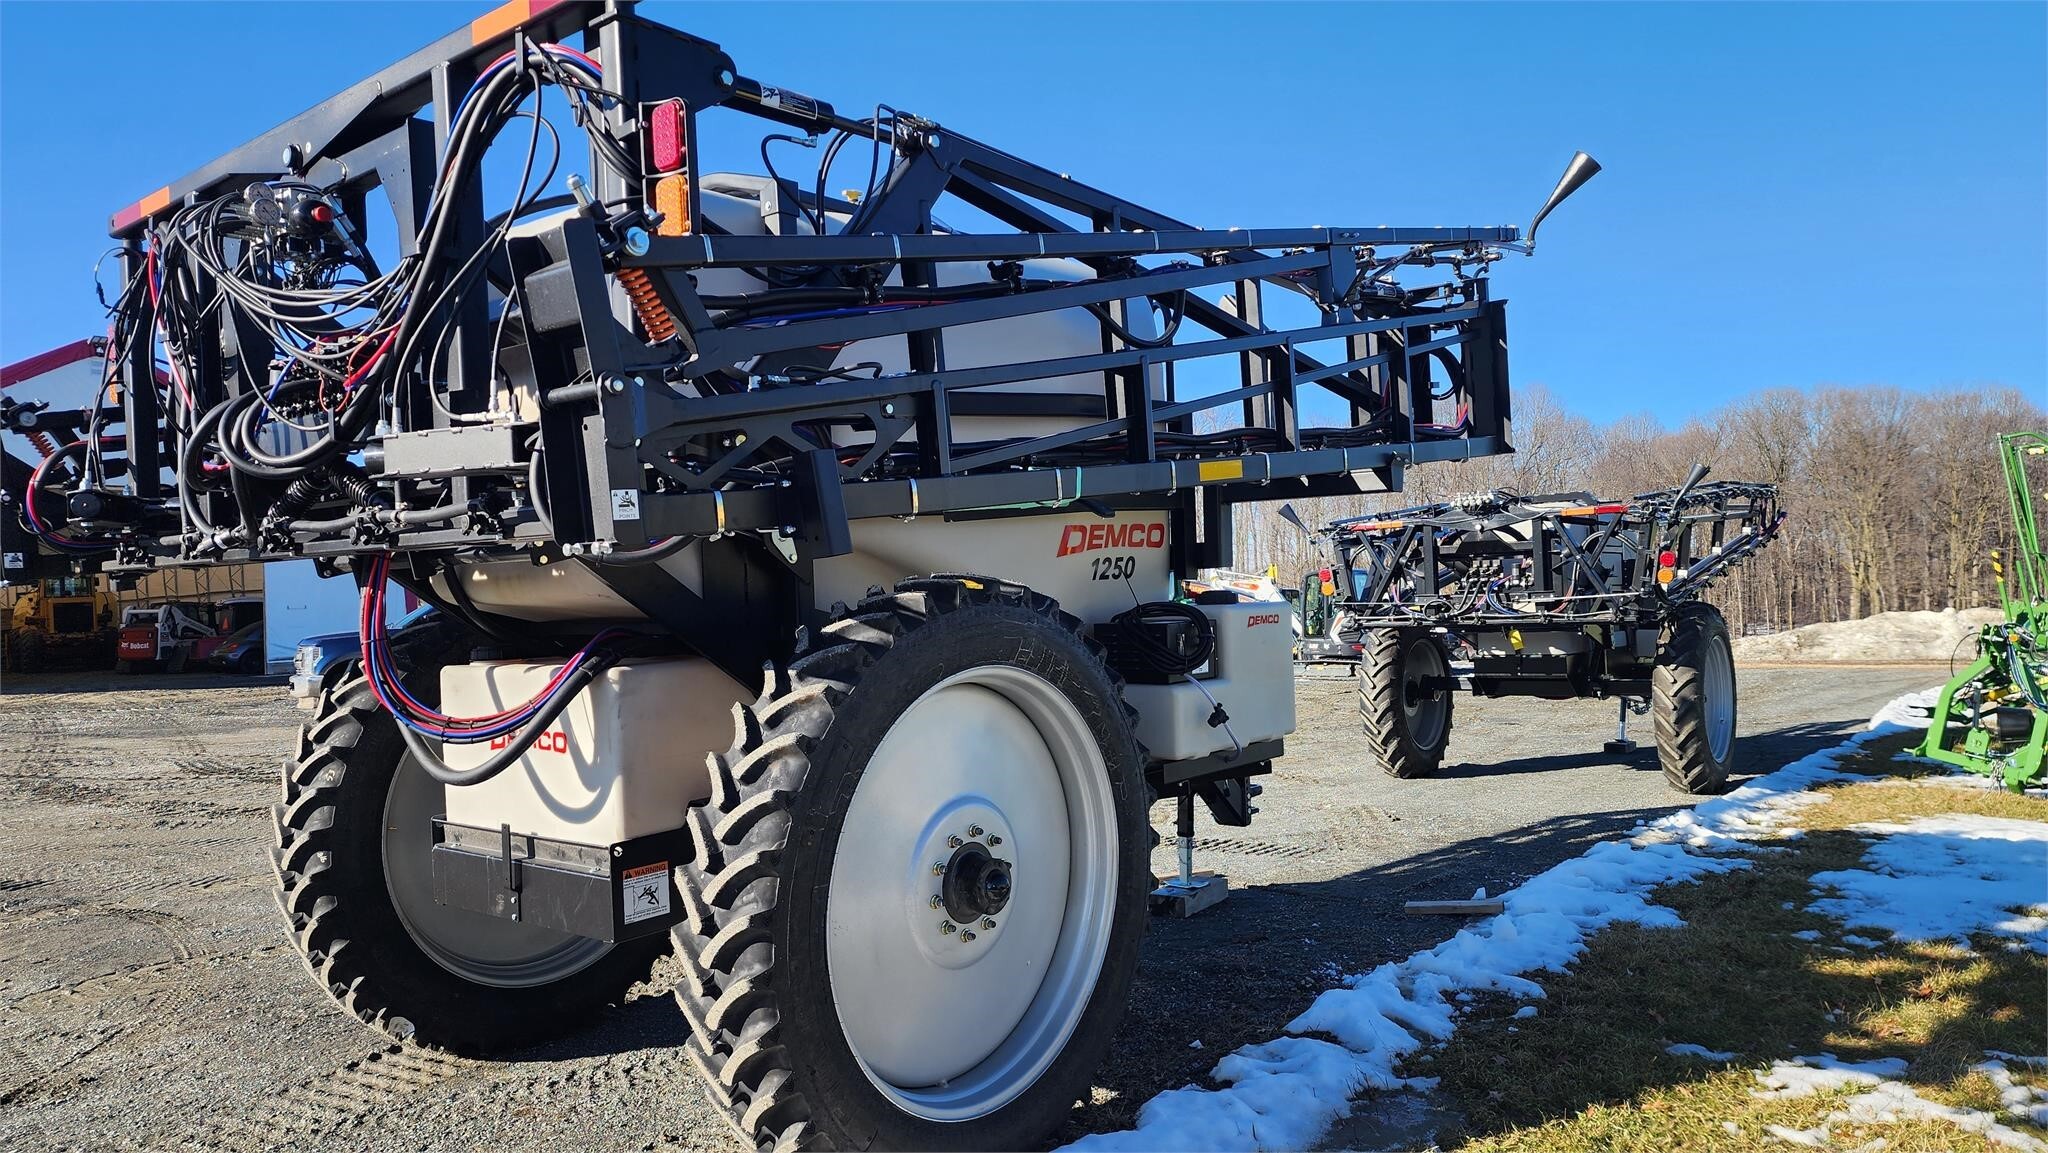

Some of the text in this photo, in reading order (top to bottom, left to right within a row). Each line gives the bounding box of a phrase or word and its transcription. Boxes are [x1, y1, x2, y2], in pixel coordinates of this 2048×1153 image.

[1056, 523, 1165, 558] DEMCO
[1091, 556, 1136, 581] 1250
[1247, 614, 1280, 628] DEMCO
[634, 863, 666, 877] WARNING
